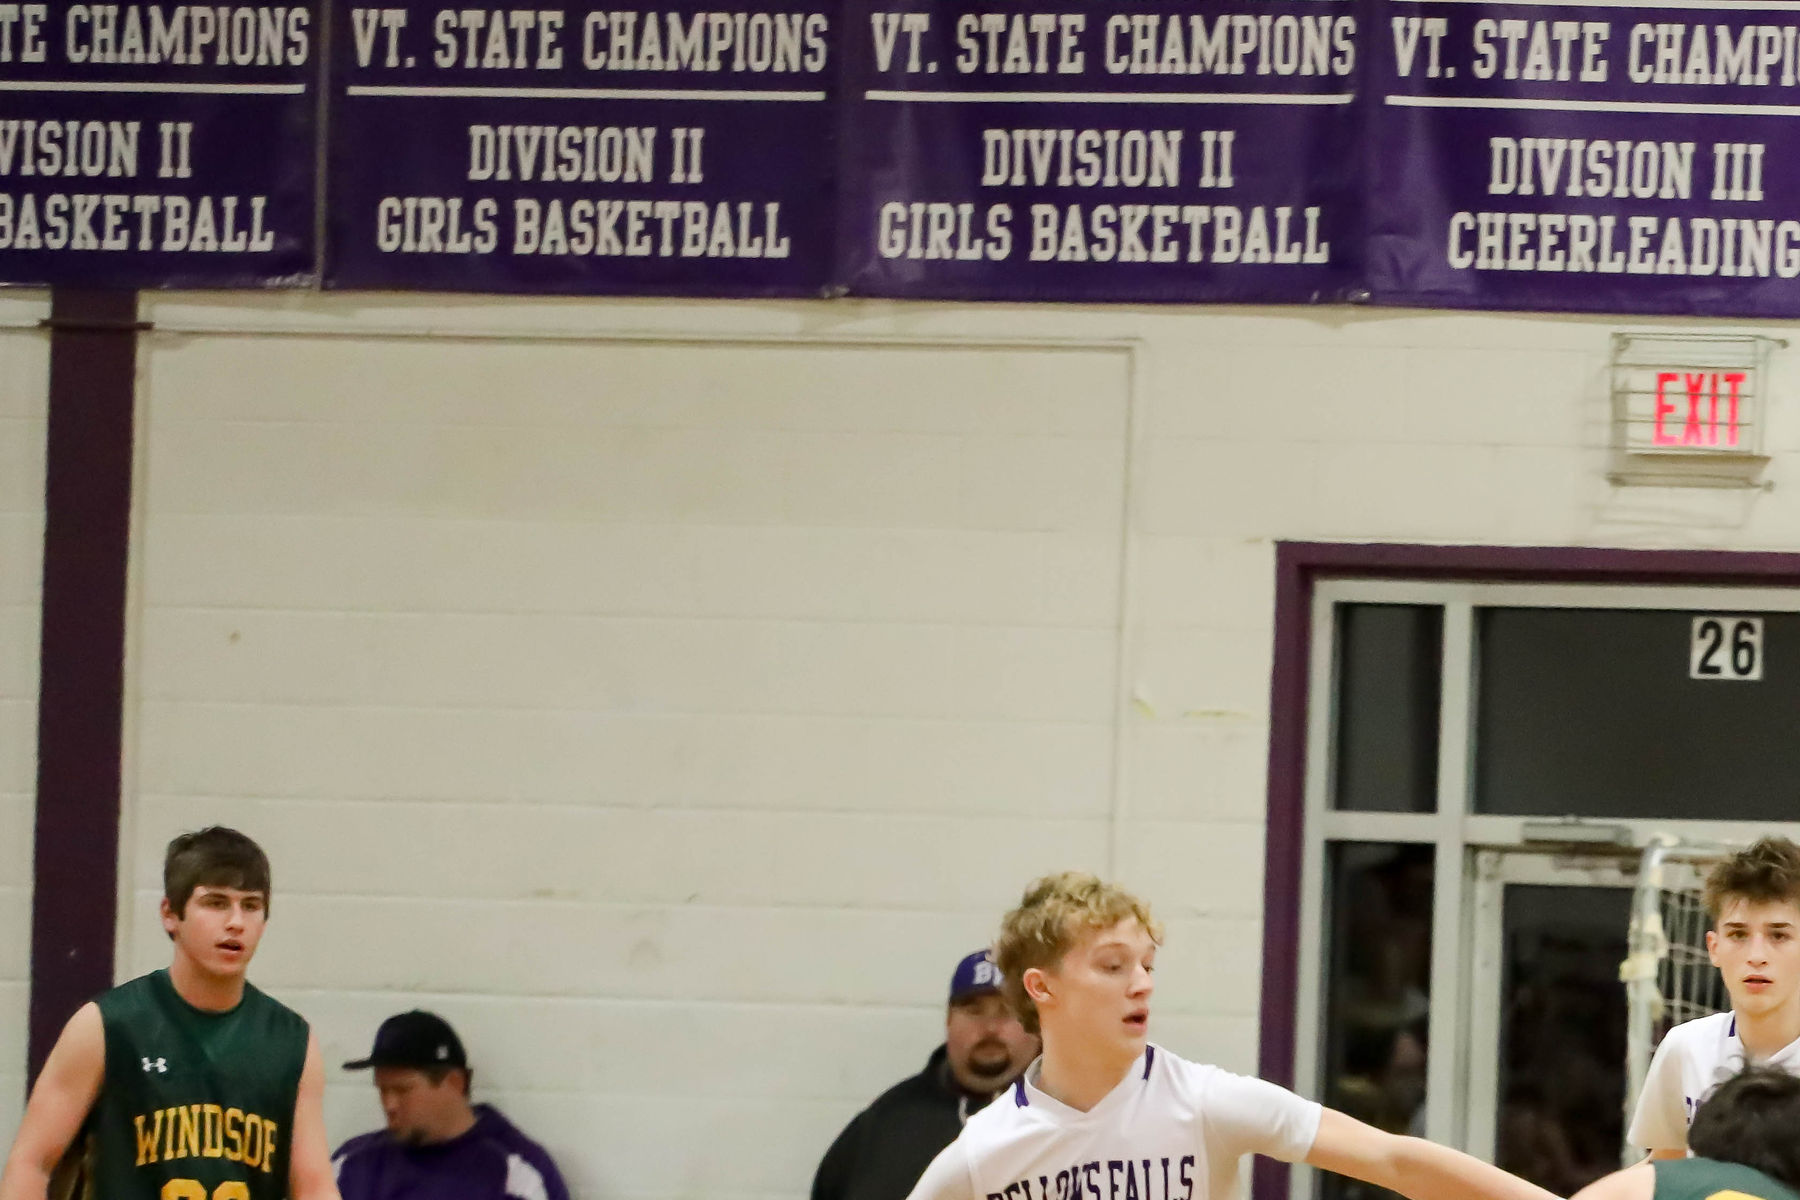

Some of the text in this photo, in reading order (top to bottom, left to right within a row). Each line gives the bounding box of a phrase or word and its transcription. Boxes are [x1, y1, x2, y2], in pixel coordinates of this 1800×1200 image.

[66, 4, 310, 66] CHAMPIONS
[353, 8, 828, 73] VT. STATE CHAMPIONS
[871, 12, 1357, 77] VT. STATE CHAMPIONS
[1391, 17, 1456, 79] VT.
[1473, 19, 1611, 83] STATE
[158, 121, 193, 179] II
[467, 124, 705, 184] DIVISION II
[981, 128, 1235, 189] DIVISION II
[1488, 136, 1766, 202] DIVISION III
[377, 196, 791, 259] GIRLS BASKETBALL
[877, 201, 1330, 264] GIRLS BASKETBALL
[1652, 372, 1746, 446] EXIT
[1697, 620, 1757, 677] 26
